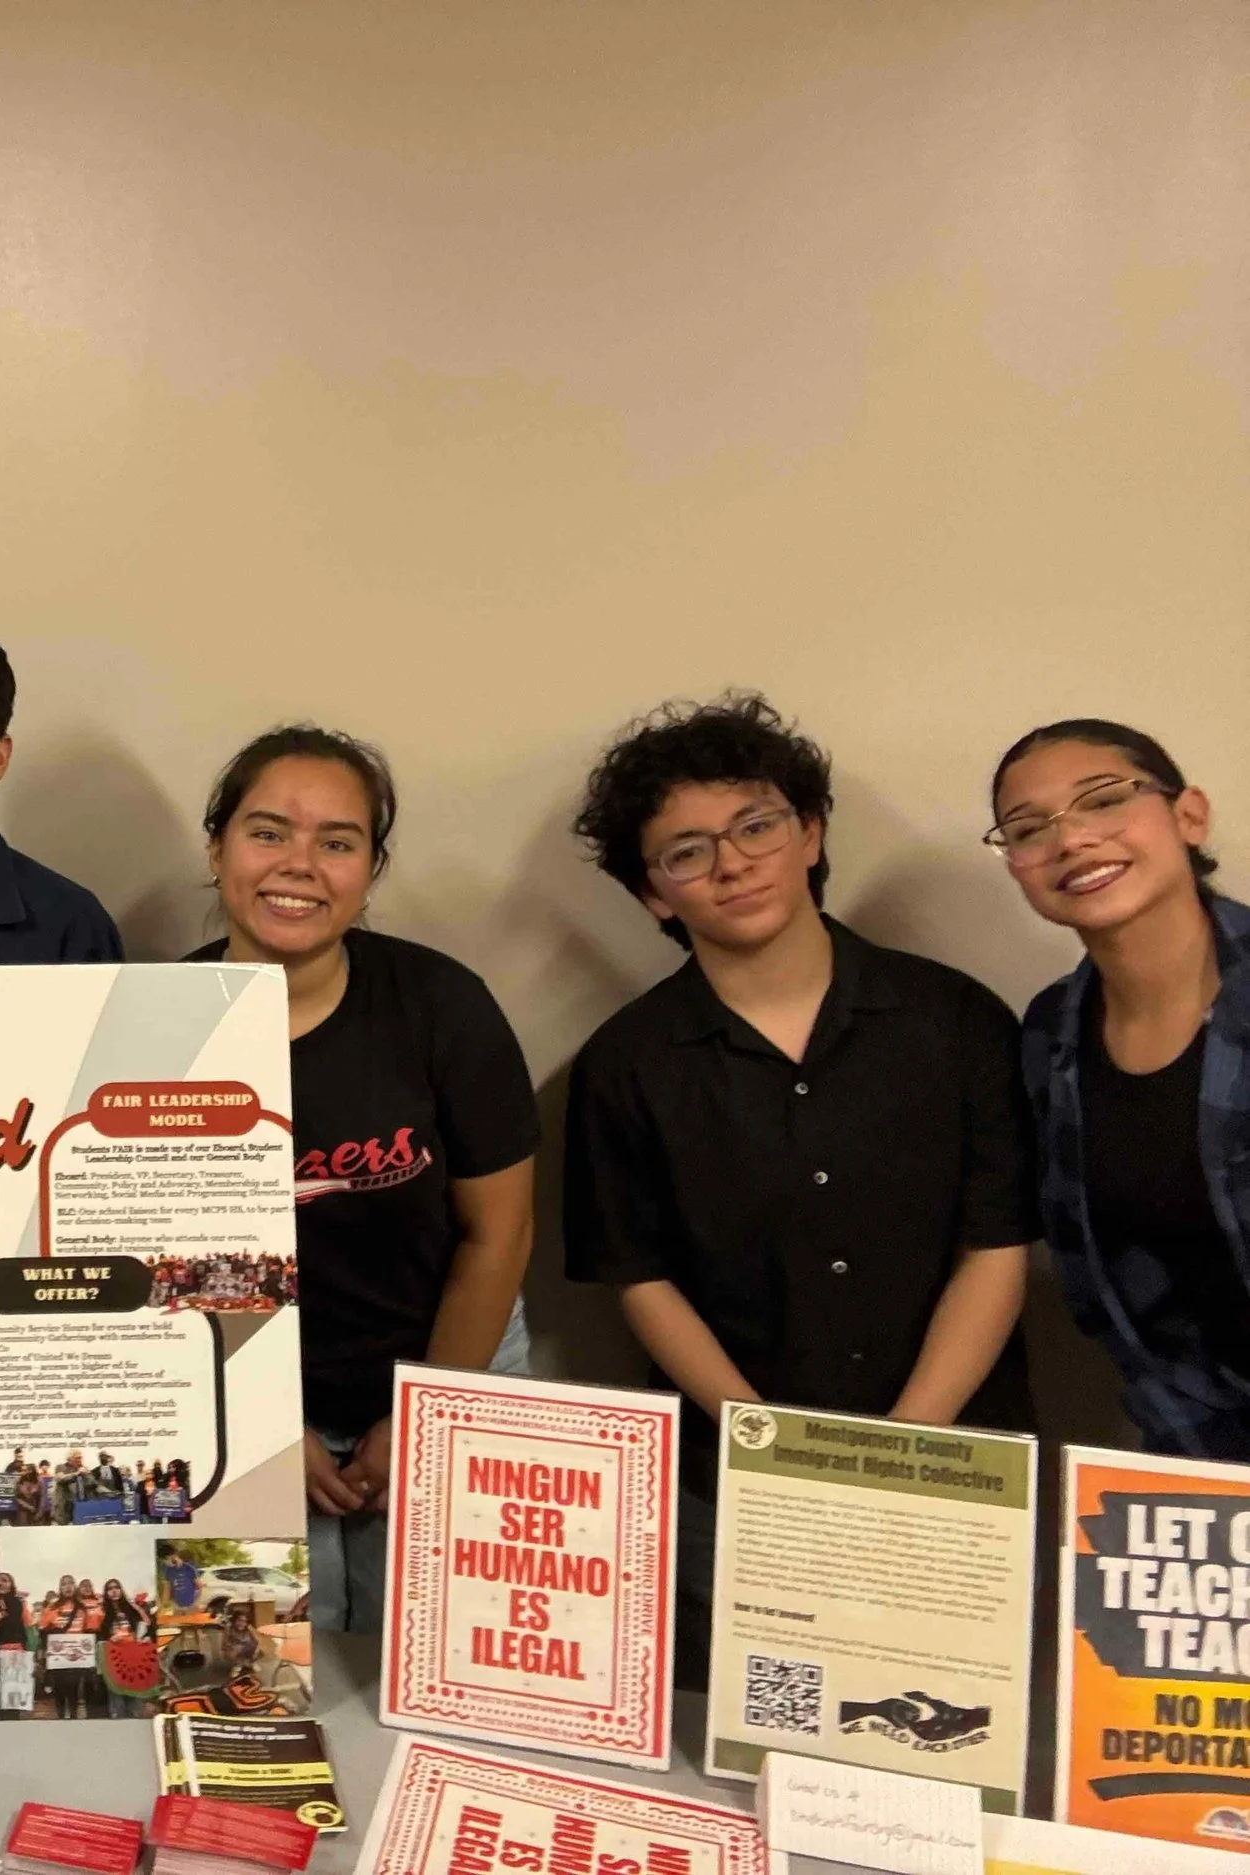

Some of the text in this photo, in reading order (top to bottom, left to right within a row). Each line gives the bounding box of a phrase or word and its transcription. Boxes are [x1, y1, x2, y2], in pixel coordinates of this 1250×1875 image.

[102, 1094, 253, 1108] FAIR LEADERSHIP
[150, 1114, 207, 1126] MODEL
[85, 1155, 133, 1164] Leadership
[207, 1153, 240, 1161] General
[243, 1153, 265, 1162] Body
[22, 1267, 112, 1281] WHAT WE
[34, 1287, 100, 1301] OFFER?
[805, 1421, 975, 1462] Montgomery County
[467, 1455, 602, 1510] NINGUN
[773, 1443, 1004, 1492] Immigrant Rights Collective
[500, 1502, 566, 1547] SER
[1126, 1504, 1217, 1560] LET
[407, 1498, 424, 1601] BARRIO DRIVE
[453, 1538, 610, 1597] HUMANO
[508, 1588, 551, 1632] ES
[640, 1592, 654, 1637] DRIVE
[471, 1626, 587, 1681] ILEGAL
[1154, 1693, 1200, 1728] NO
